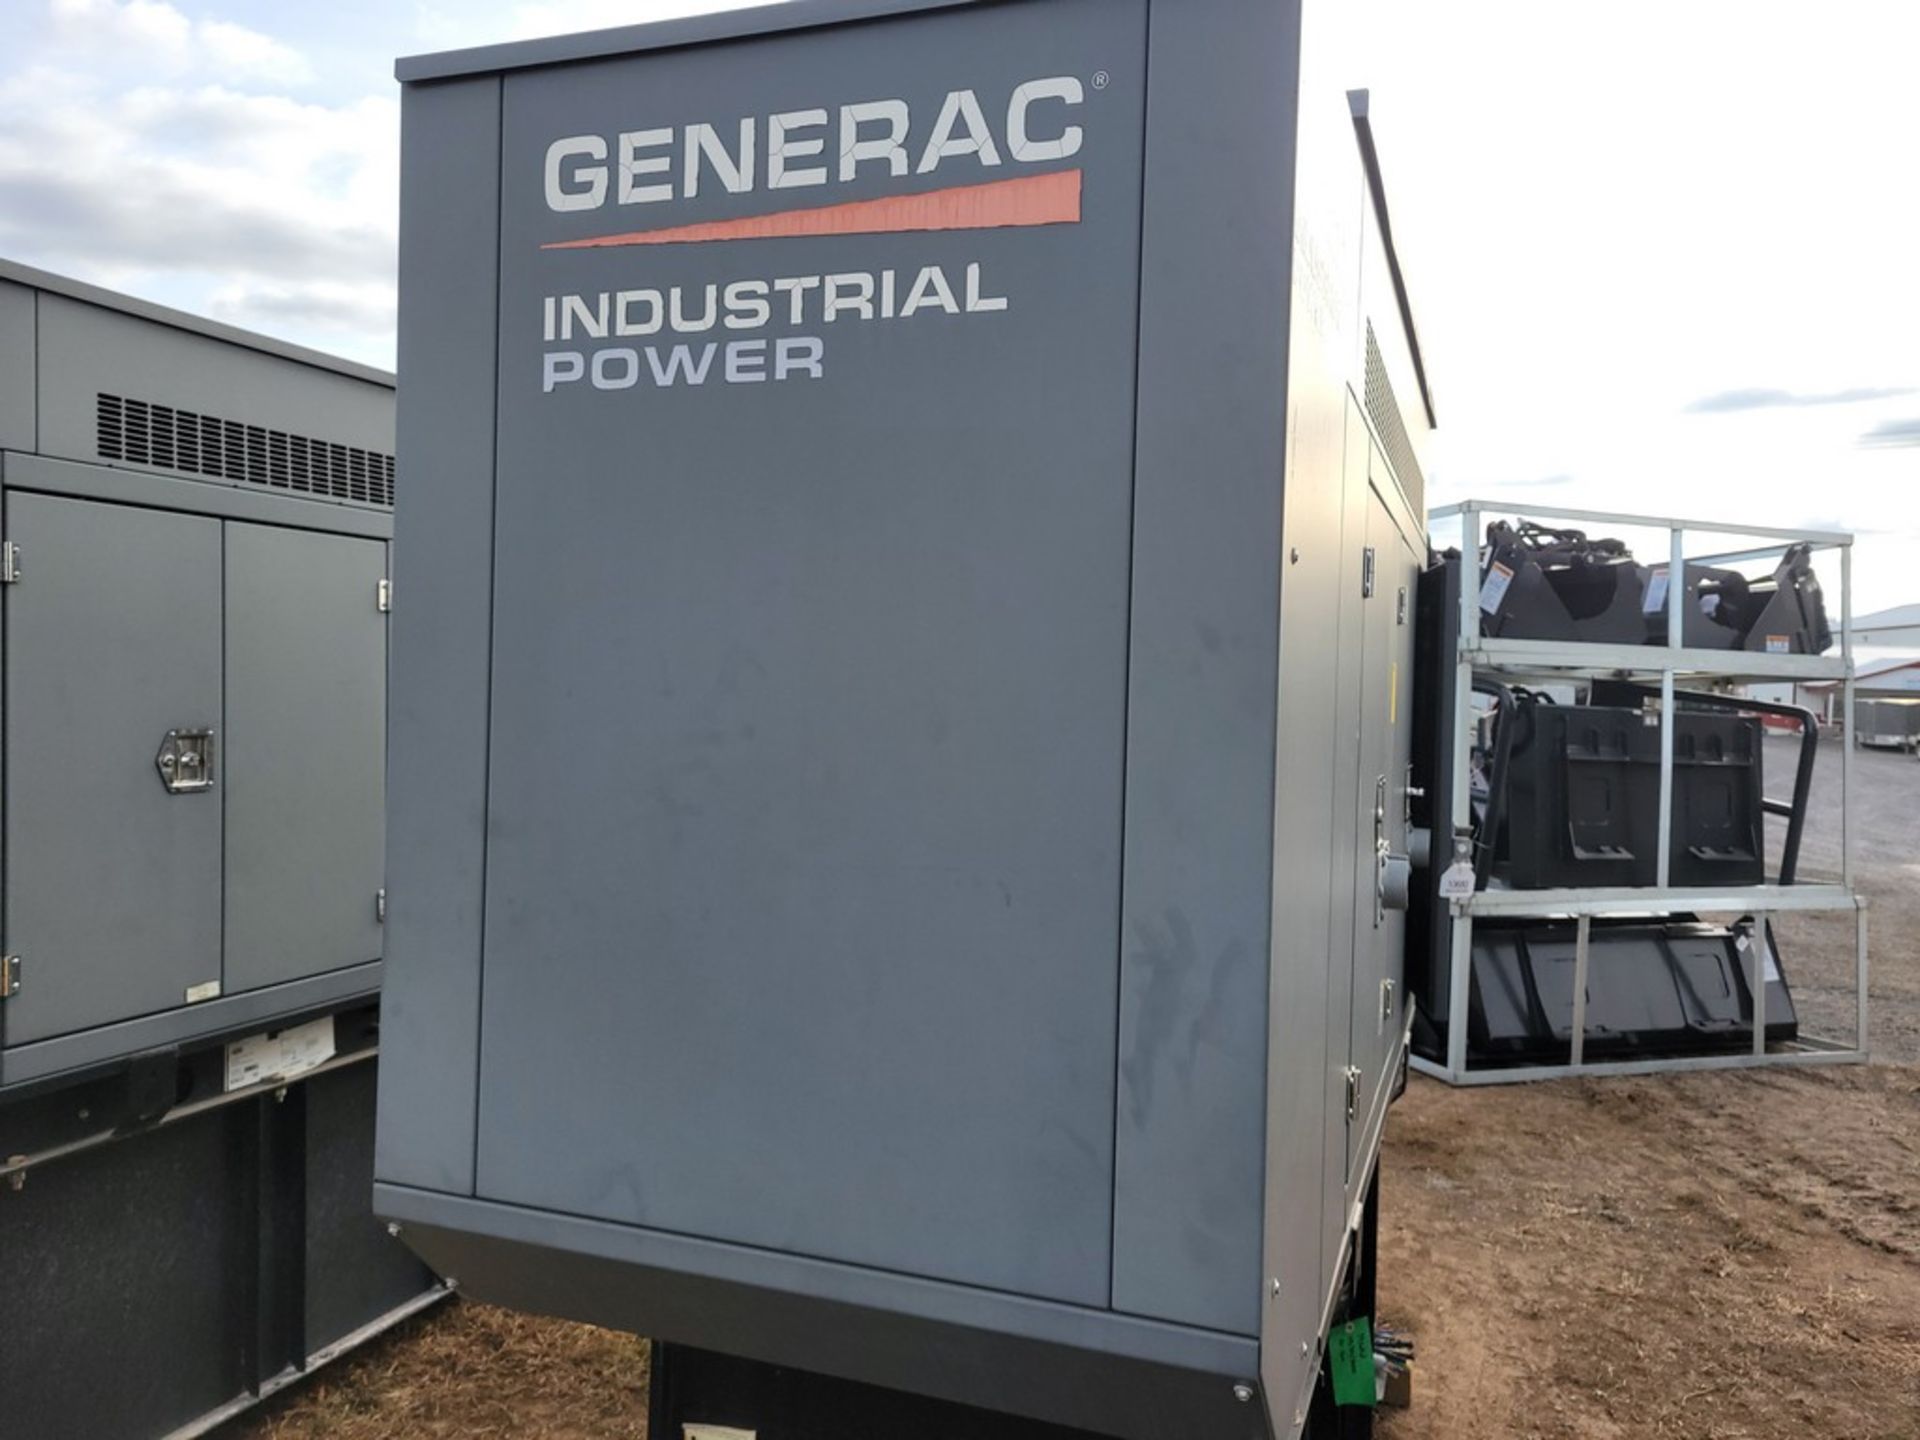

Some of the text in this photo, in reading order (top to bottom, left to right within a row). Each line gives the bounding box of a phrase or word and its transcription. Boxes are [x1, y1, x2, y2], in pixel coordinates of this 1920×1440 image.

[544, 76, 1084, 213] GENERAC
[543, 262, 1008, 341] INDUSTRIAL
[543, 336, 824, 393] POWER
